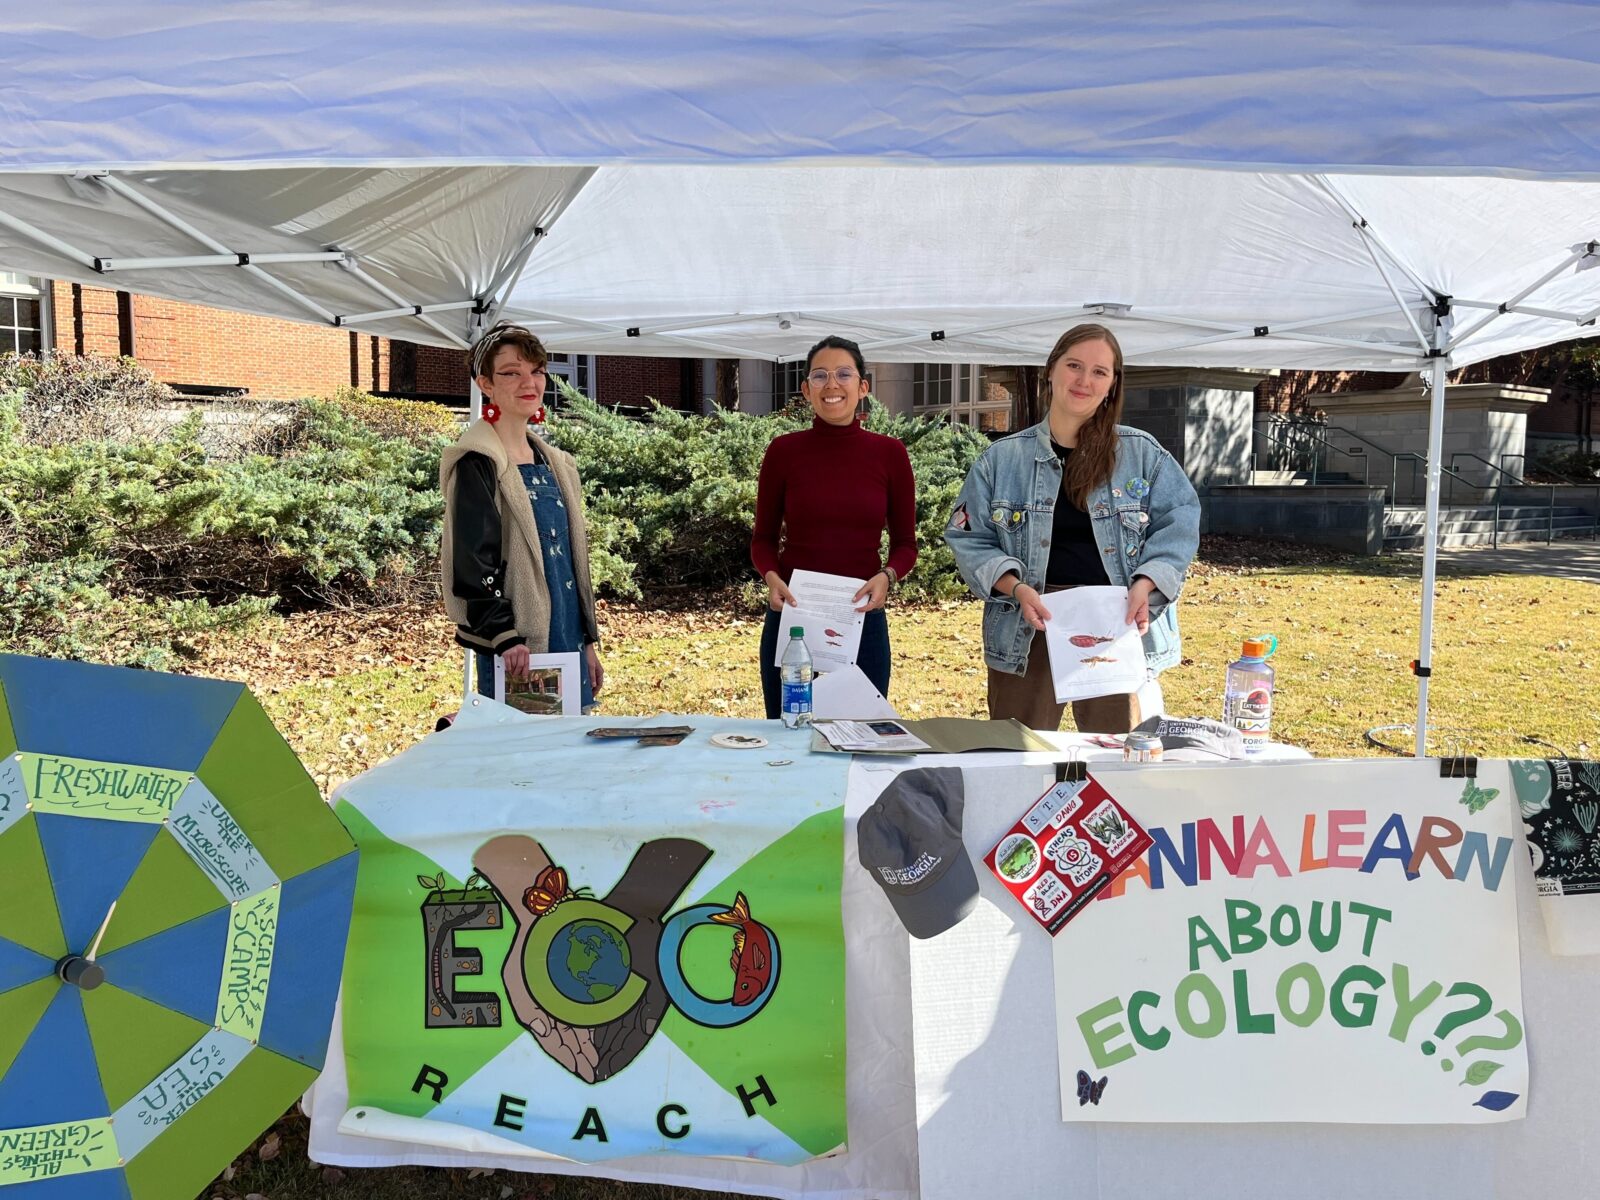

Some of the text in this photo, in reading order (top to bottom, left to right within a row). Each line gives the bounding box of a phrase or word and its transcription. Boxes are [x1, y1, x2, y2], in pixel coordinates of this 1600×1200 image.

[1168, 726, 1206, 735] GEORG
[34, 758, 182, 810] FRESHWATER
[1553, 760, 1574, 790] ATER
[211, 804, 254, 855] UNDER
[1055, 799, 1077, 824] DAWG
[173, 812, 249, 897] MICROSCOPE
[217, 822, 240, 854] THE
[1069, 850, 1078, 862] IS
[1097, 809, 1513, 900] ANNA LEARN
[897, 855, 936, 881] GEORGIA
[1074, 858, 1100, 884] ATOMIC
[1050, 890, 1069, 908] DNA
[1187, 898, 1392, 972] ABOUT
[221, 911, 258, 1023] SCAMPS
[251, 917, 275, 996] SCALY
[420, 889, 782, 1029] ECO
[1076, 962, 1523, 1072] ECOLOGY??
[138, 1049, 210, 1111] SEA
[161, 1071, 224, 1126] UNDER
[0, 1124, 90, 1153] GREEN
[3, 1148, 80, 1171] THINGS
[22, 1161, 62, 1178] ALL
